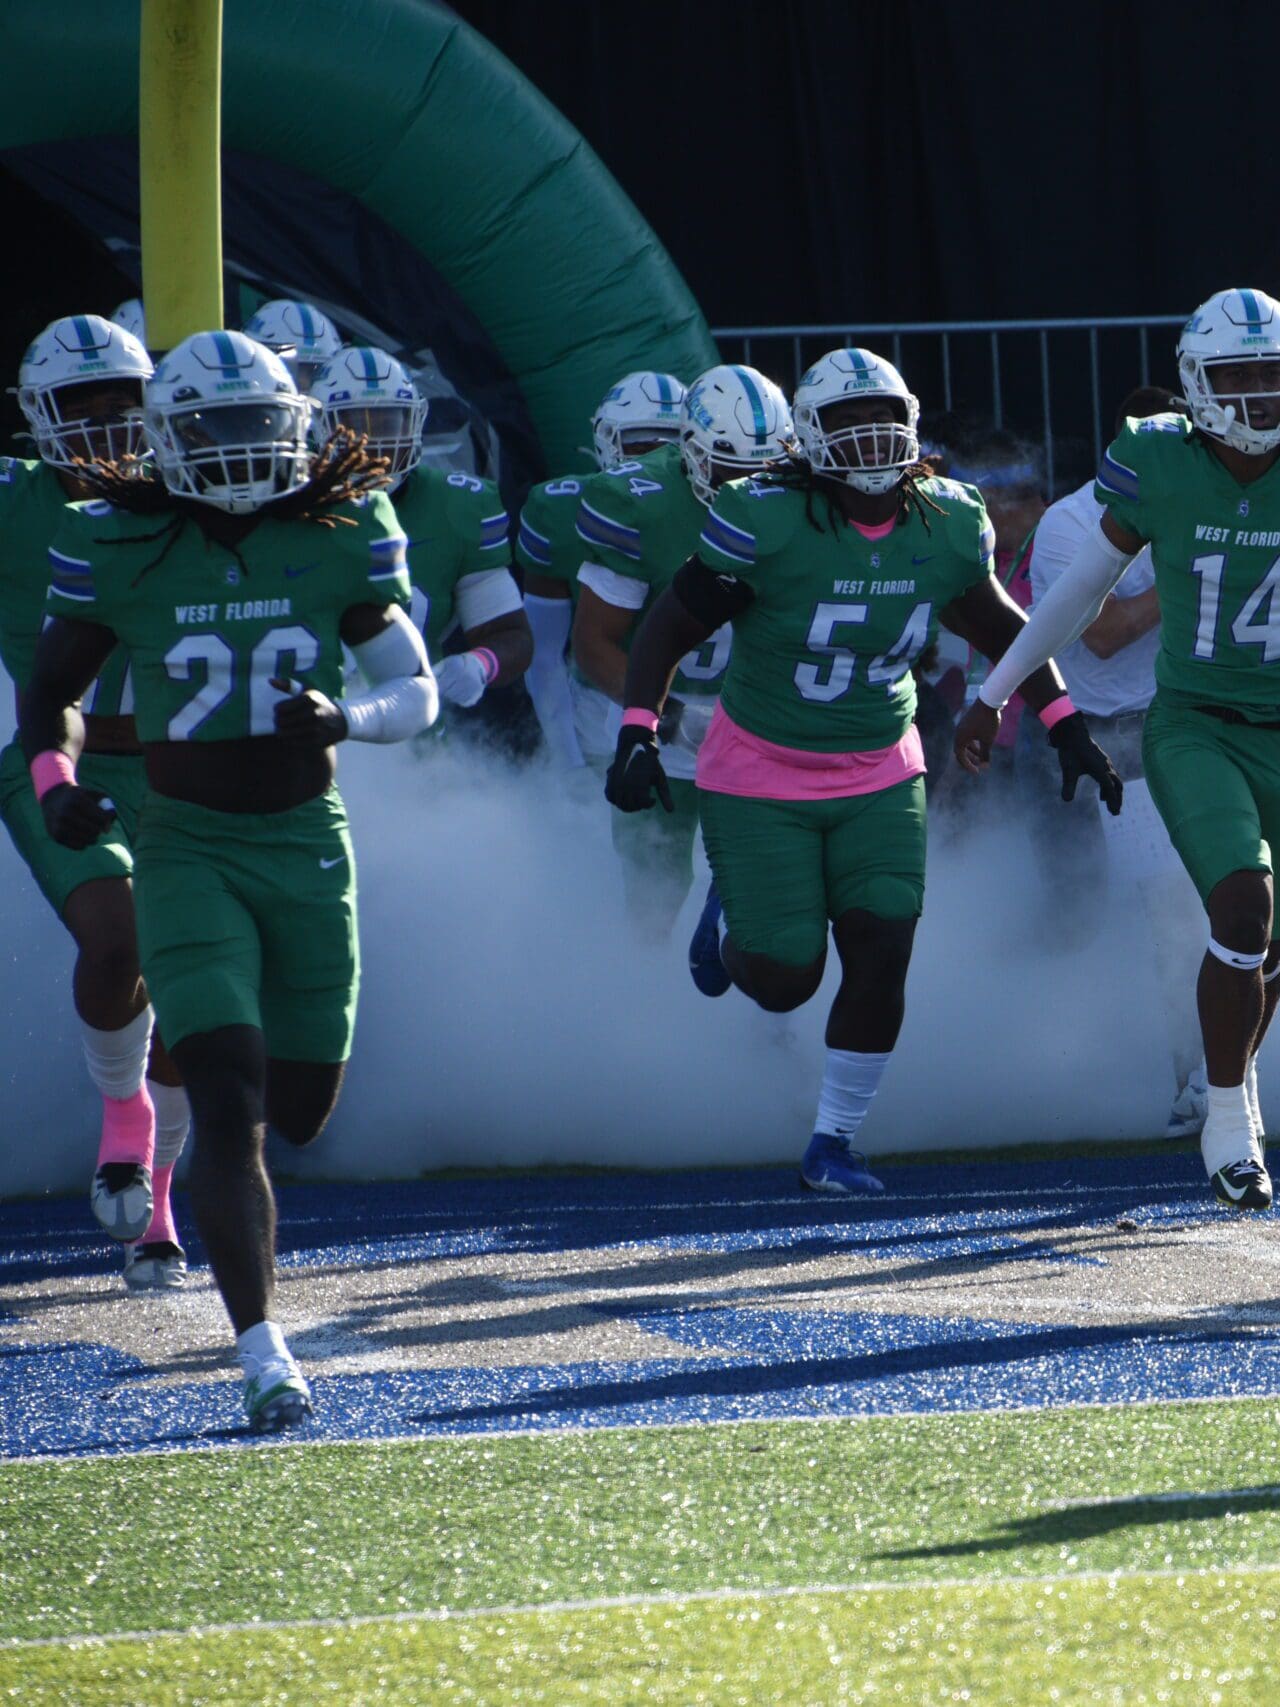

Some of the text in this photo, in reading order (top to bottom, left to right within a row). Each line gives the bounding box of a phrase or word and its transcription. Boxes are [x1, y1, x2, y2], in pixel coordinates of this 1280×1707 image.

[1195, 525, 1230, 543] WEST
[834, 579, 915, 595] WEST FLORIDA
[175, 598, 291, 624] WEST FLORIDA
[793, 601, 933, 702] 54
[163, 624, 319, 741] 26
